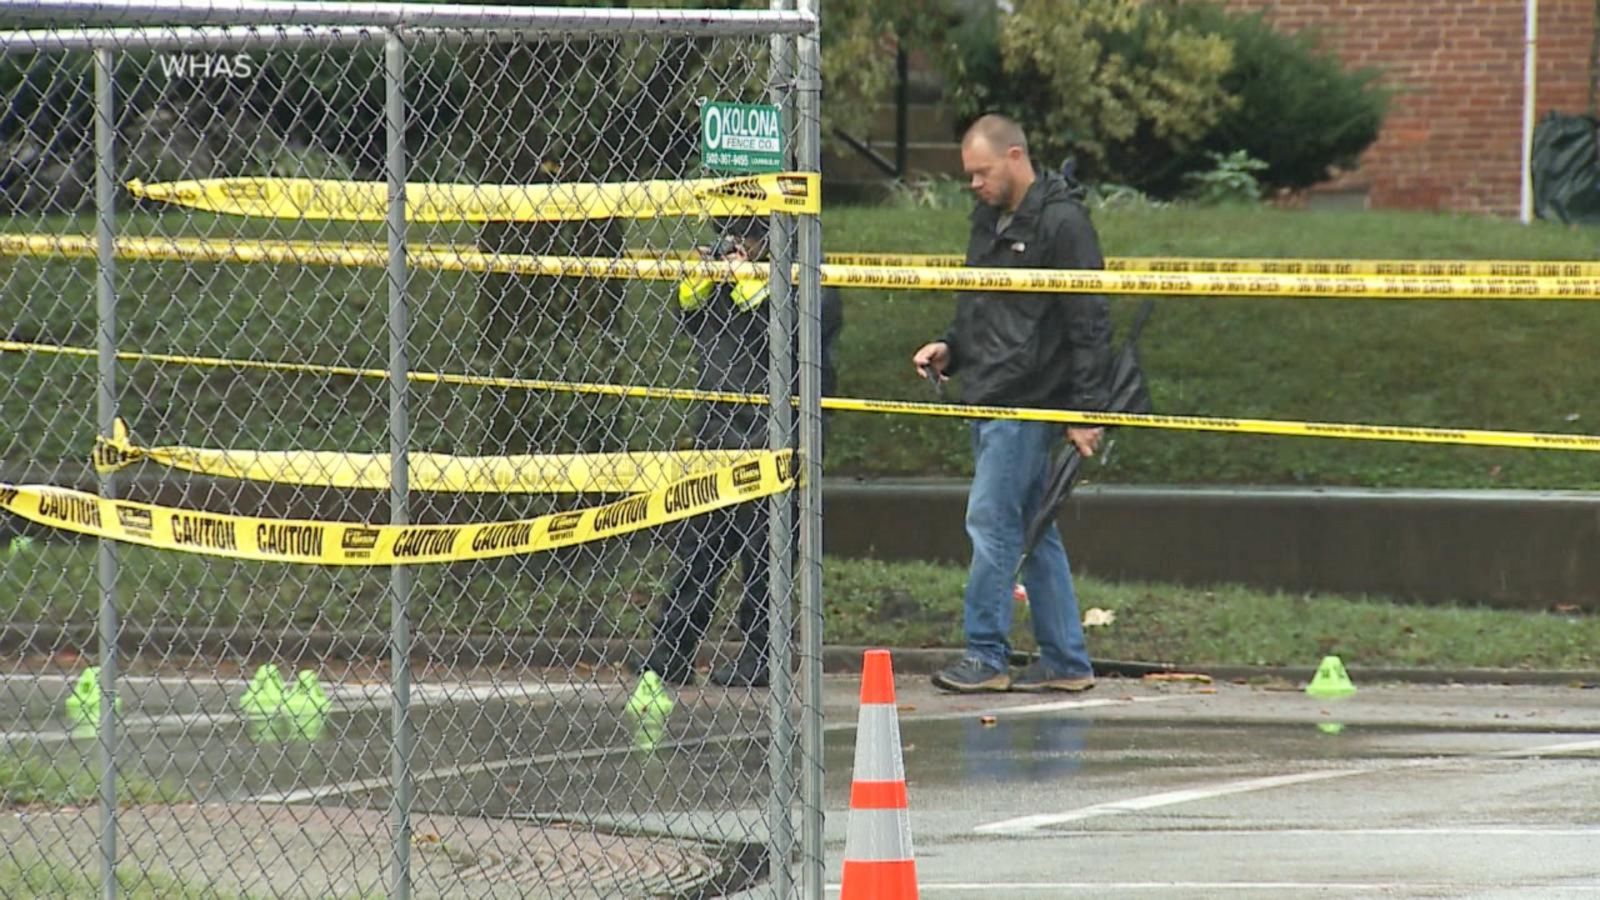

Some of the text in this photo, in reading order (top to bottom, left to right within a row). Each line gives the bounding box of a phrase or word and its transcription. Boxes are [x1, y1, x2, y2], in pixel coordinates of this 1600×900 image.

[705, 106, 779, 149] OKOLONA
[726, 138, 774, 150] FENCE CO.
[39, 491, 103, 528] CAUTION
[171, 514, 237, 550] CAUTION
[257, 523, 324, 556] CAUTION
[393, 529, 460, 557] CAUTION
[472, 523, 534, 552] CAUTION
[594, 494, 651, 532] CAUTION
[664, 472, 719, 514] CAUTION
